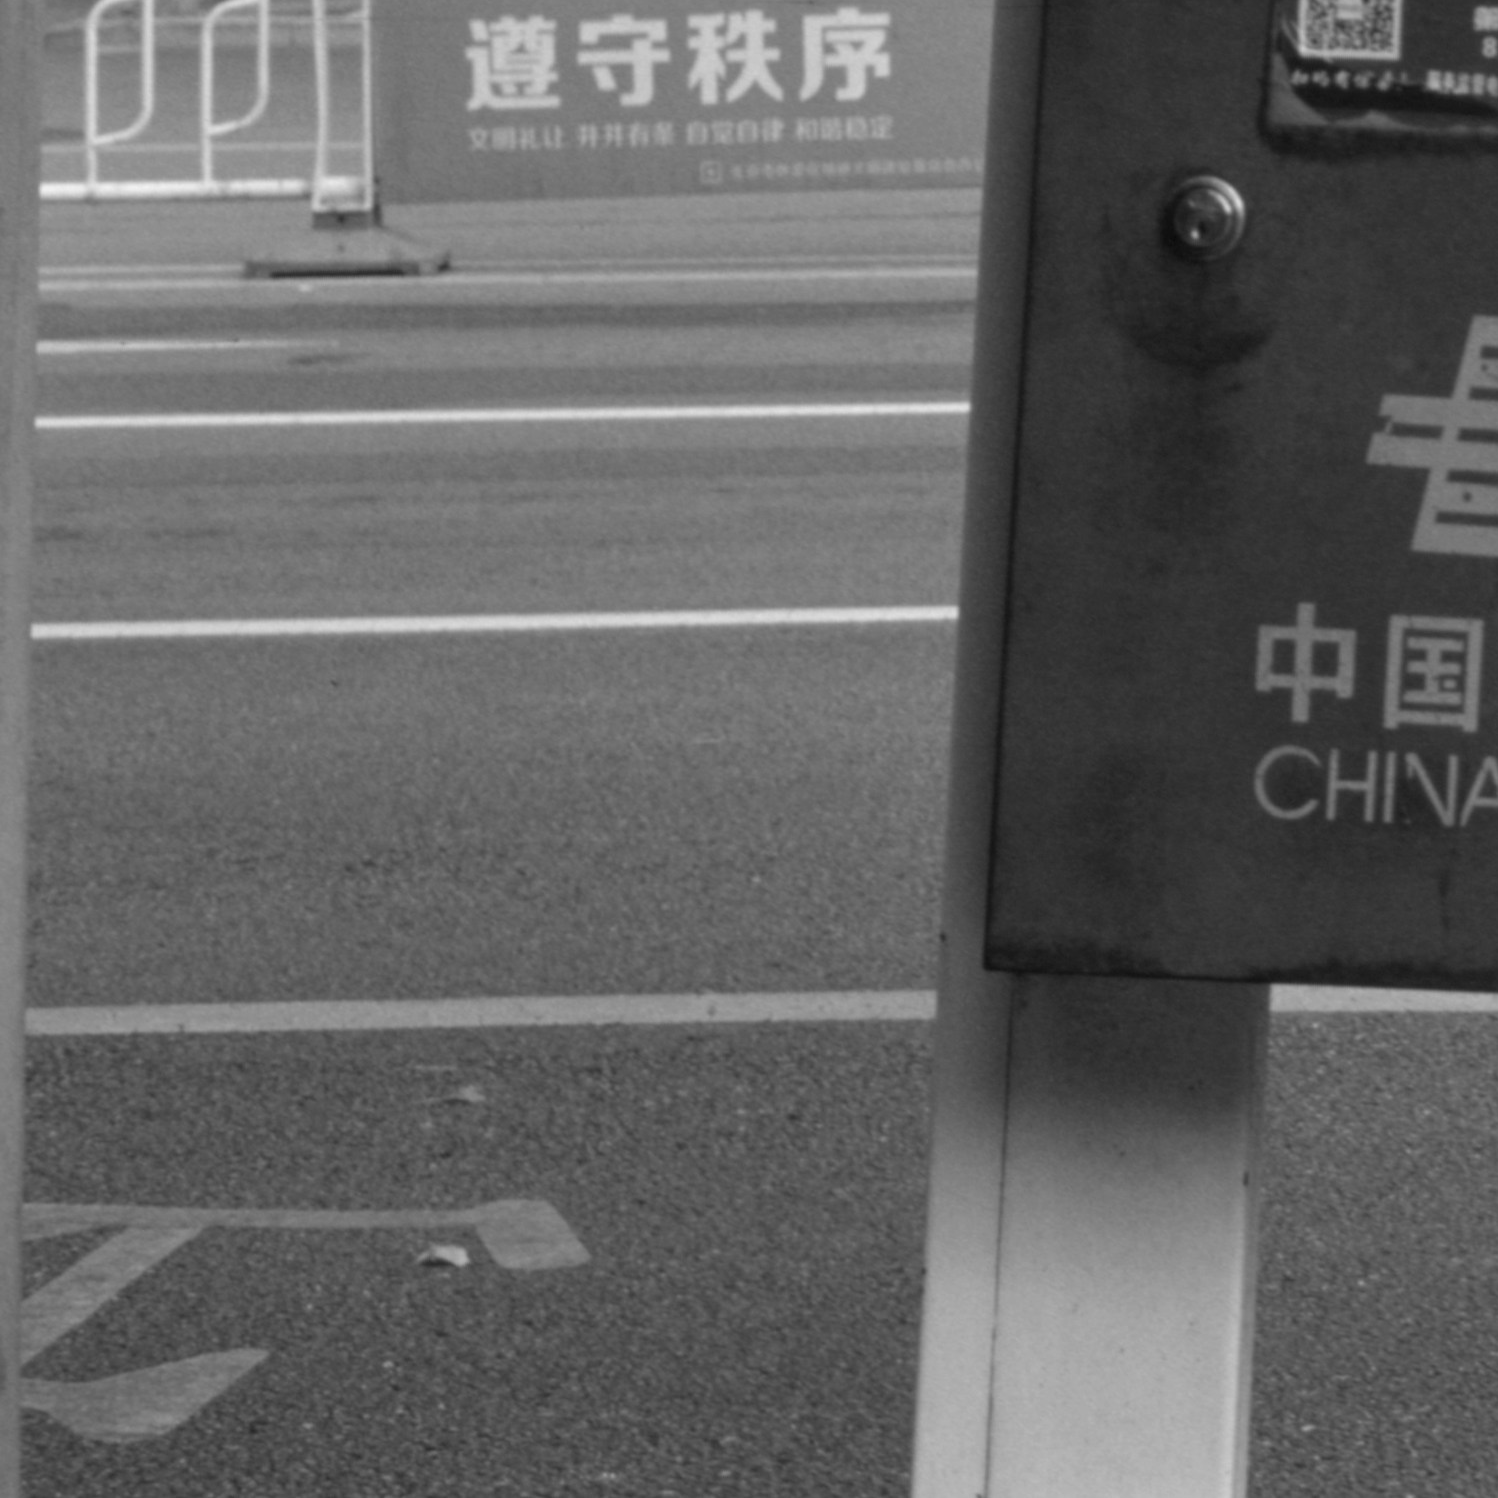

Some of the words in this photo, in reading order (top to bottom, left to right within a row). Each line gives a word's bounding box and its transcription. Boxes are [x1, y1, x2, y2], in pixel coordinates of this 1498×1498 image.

[465, 6, 891, 111] 遵守秩序
[467, 126, 563, 152] 文明礼让
[577, 120, 676, 148] 井井有条
[686, 117, 784, 146] 自觉自律
